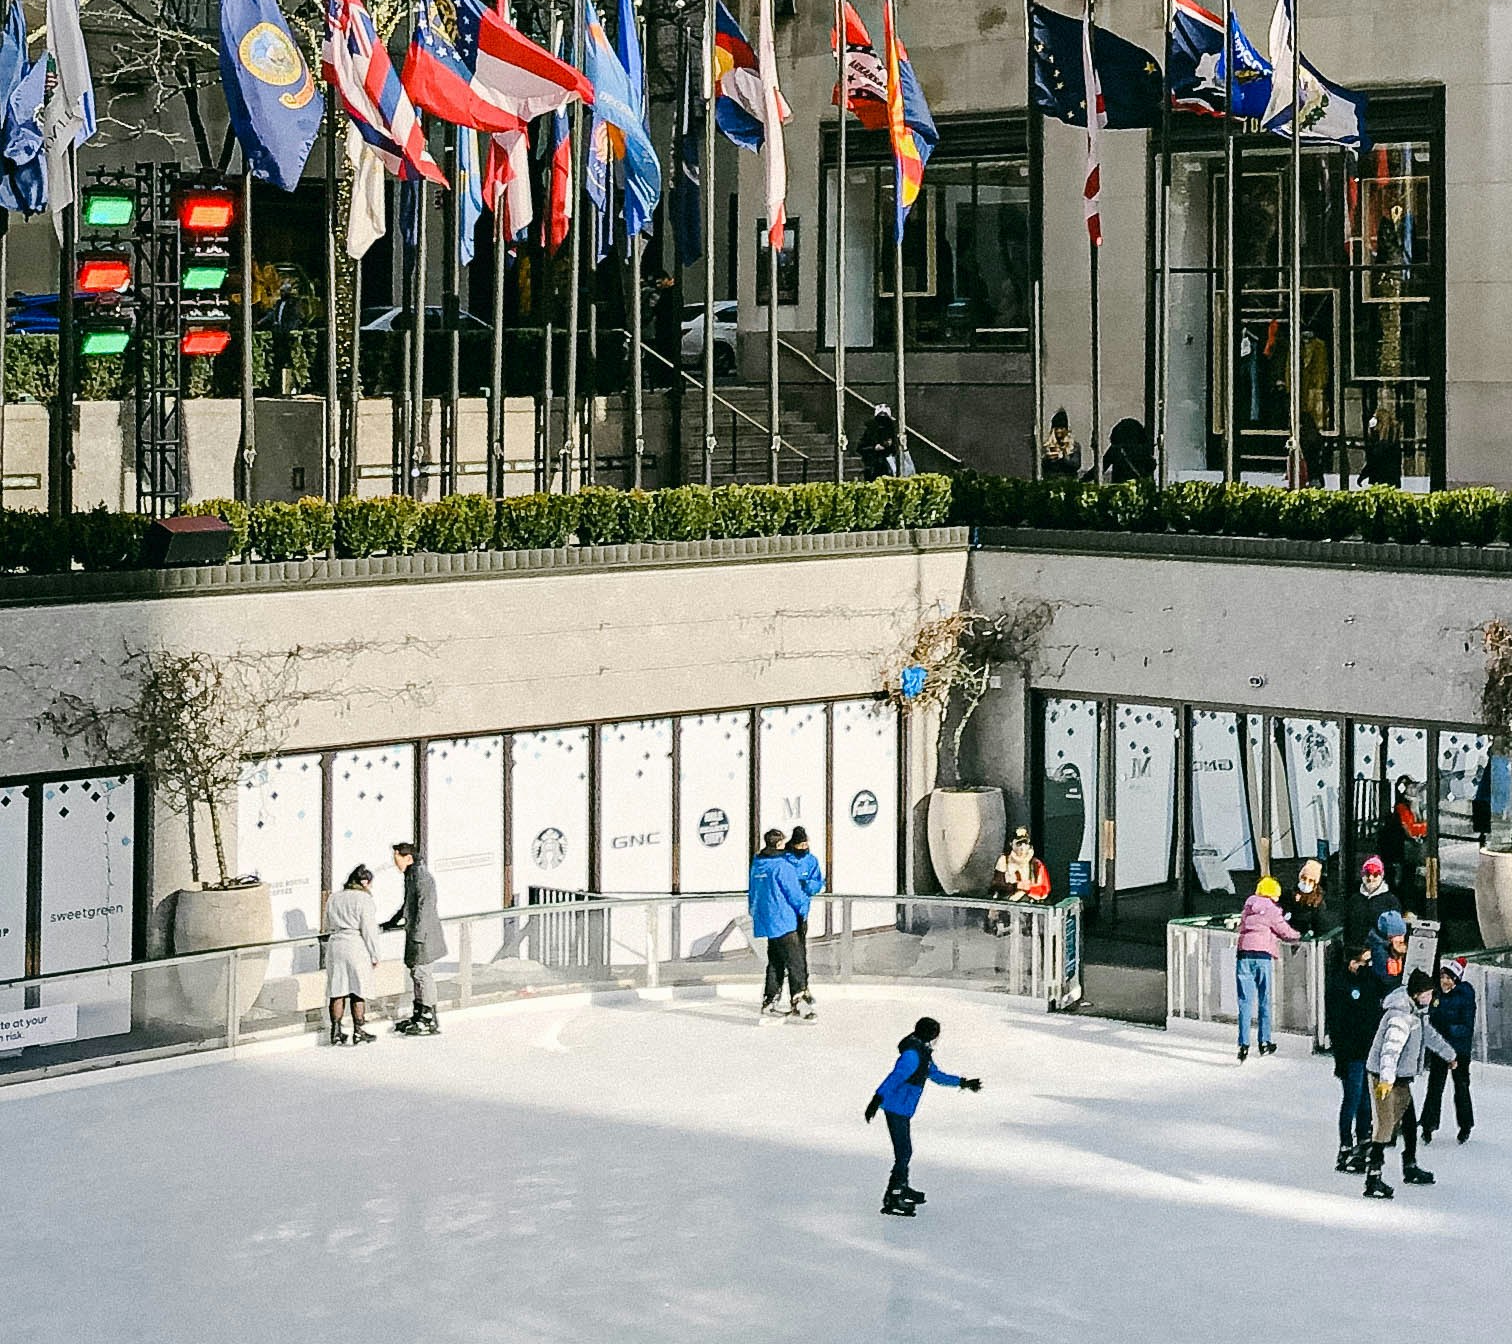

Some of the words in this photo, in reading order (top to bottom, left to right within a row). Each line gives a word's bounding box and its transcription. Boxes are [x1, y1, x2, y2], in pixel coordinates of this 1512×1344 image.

[612, 831, 661, 850] GNC
[50, 904, 124, 923] sweetgreen
[12, 1018, 24, 1028] at
[26, 1015, 48, 1029] your
